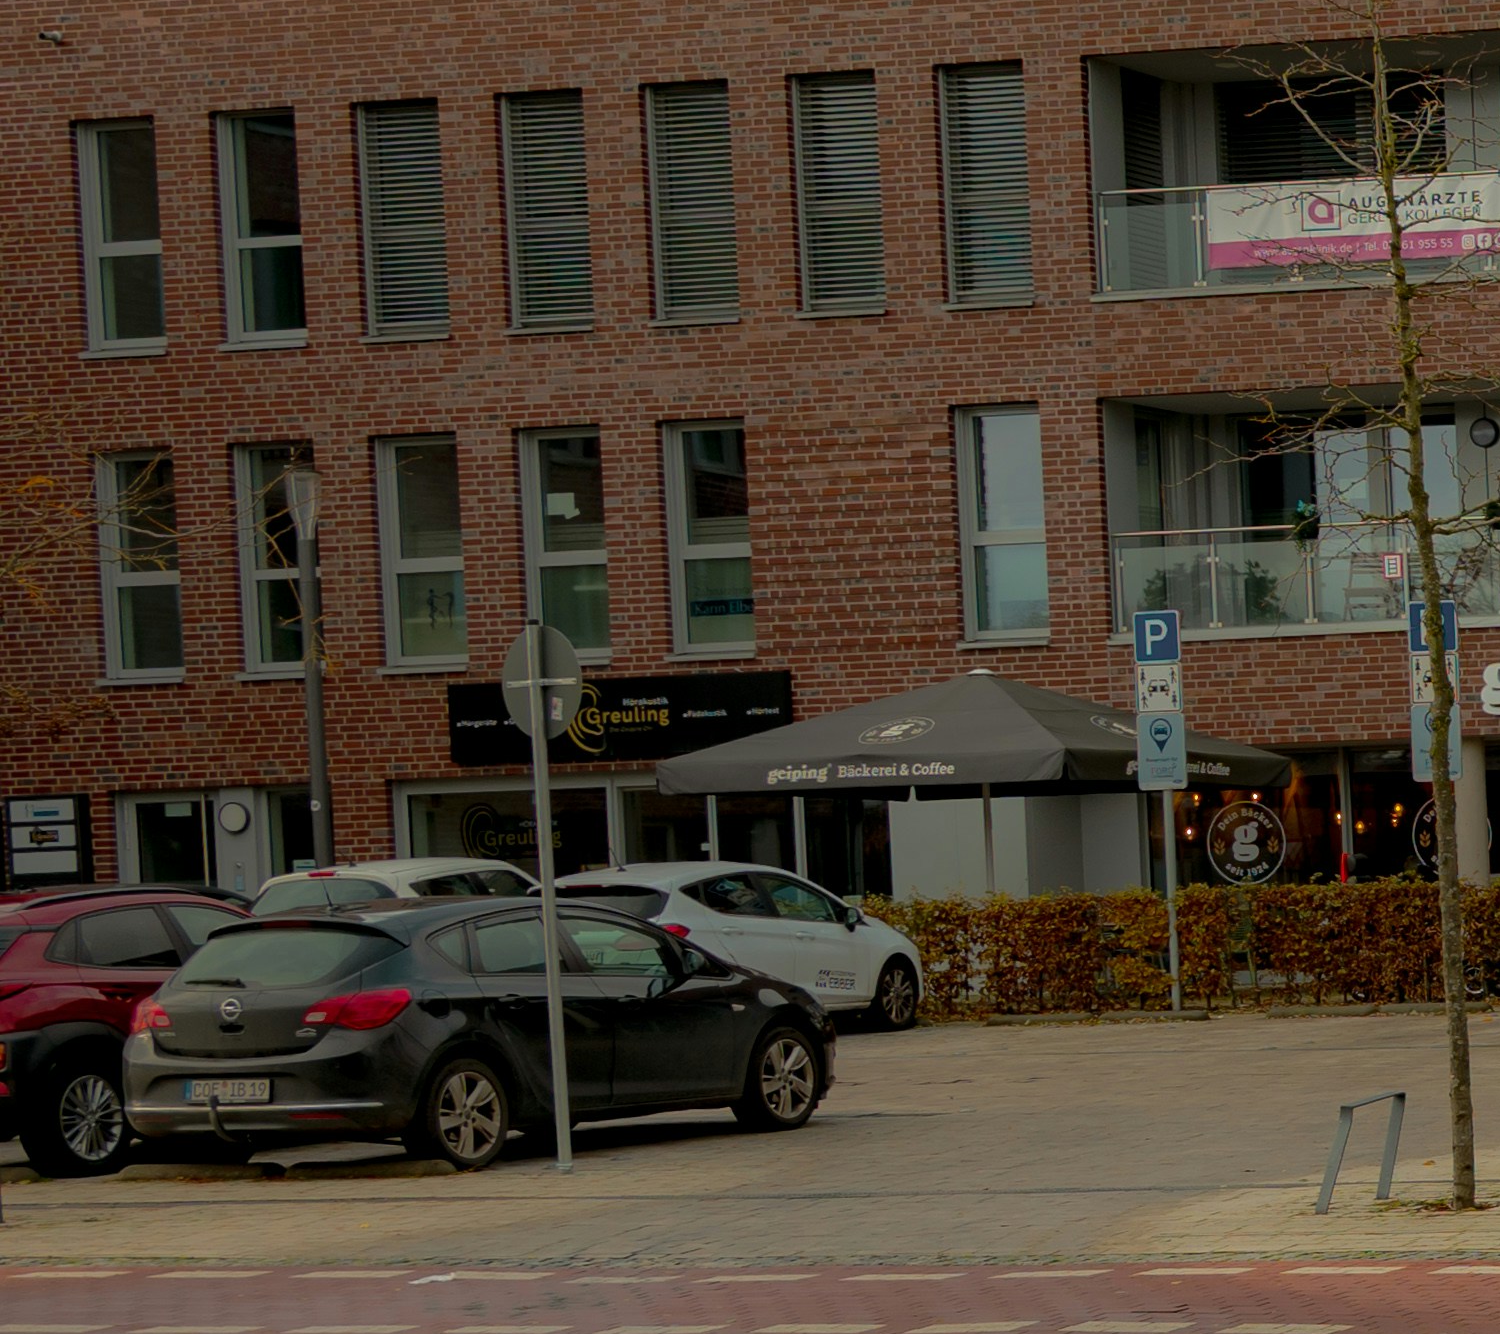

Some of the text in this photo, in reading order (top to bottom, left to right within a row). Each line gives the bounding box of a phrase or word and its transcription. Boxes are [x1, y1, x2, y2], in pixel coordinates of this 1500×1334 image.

[1349, 189, 1482, 209] AUGNÄRZTE
[1419, 238, 1437, 249] 955
[1440, 237, 1453, 248] 55
[1145, 619, 1168, 656] P
[585, 707, 670, 726] Greuling
[766, 761, 955, 785] geiping Bäckerei & Coffee
[1217, 807, 1274, 831] Dein Bäcker
[484, 827, 563, 849] Greulg
[1231, 821, 1260, 862] g
[193, 1082, 266, 1098] COE IB 19
